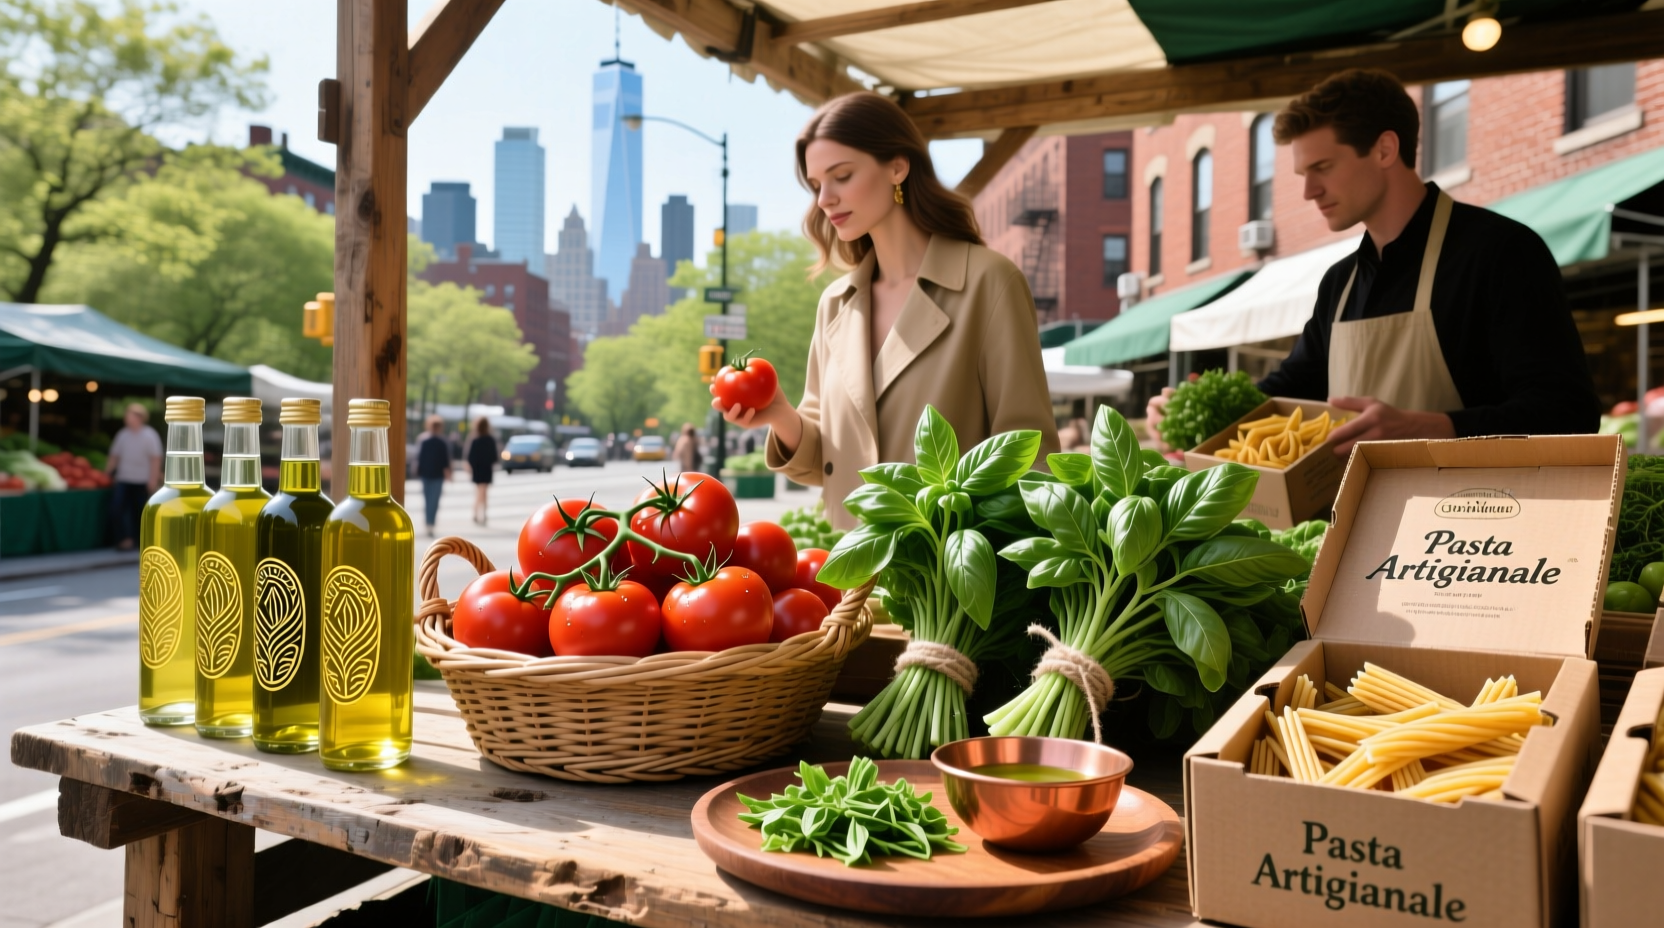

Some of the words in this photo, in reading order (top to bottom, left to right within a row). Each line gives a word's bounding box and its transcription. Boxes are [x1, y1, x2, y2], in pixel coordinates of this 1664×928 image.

[1424, 529, 1513, 556] Pasta
[1365, 554, 1561, 589] Artigianale
[1302, 820, 1404, 870] Pasta
[1251, 853, 1467, 923] Artigianale
